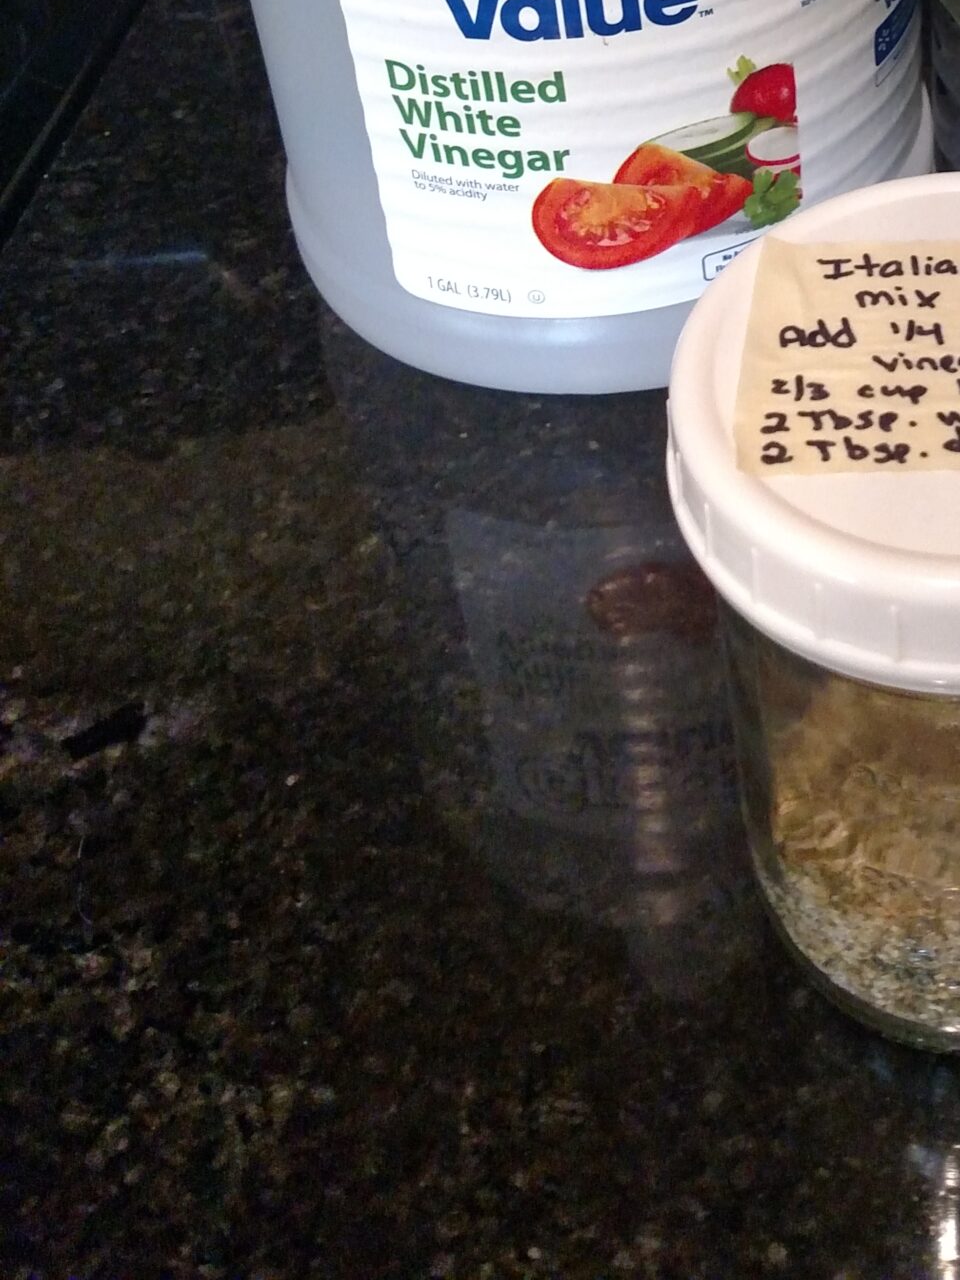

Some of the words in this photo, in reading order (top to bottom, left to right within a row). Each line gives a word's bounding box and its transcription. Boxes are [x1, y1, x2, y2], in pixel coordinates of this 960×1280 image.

[385, 58, 567, 103] Distilled
[392, 94, 521, 138] White
[399, 128, 570, 179] Vinegar
[411, 169, 453, 186] Diluted
[456, 178, 482, 189] with
[485, 183, 520, 192] water
[414, 181, 426, 190] to
[429, 183, 447, 194] 5%
[449, 187, 488, 201] acidity
[427, 276, 433, 288] 1
[437, 278, 461, 295] GAL
[467, 284, 512, 303] (3.79L)
[855, 286, 941, 308] mix
[779, 317, 857, 348] Add
[891, 319, 944, 346] 1/4
[771, 374, 830, 402] 2/3
[857, 384, 928, 405] cup
[760, 412, 791, 434] 2
[761, 441, 793, 465] 2
